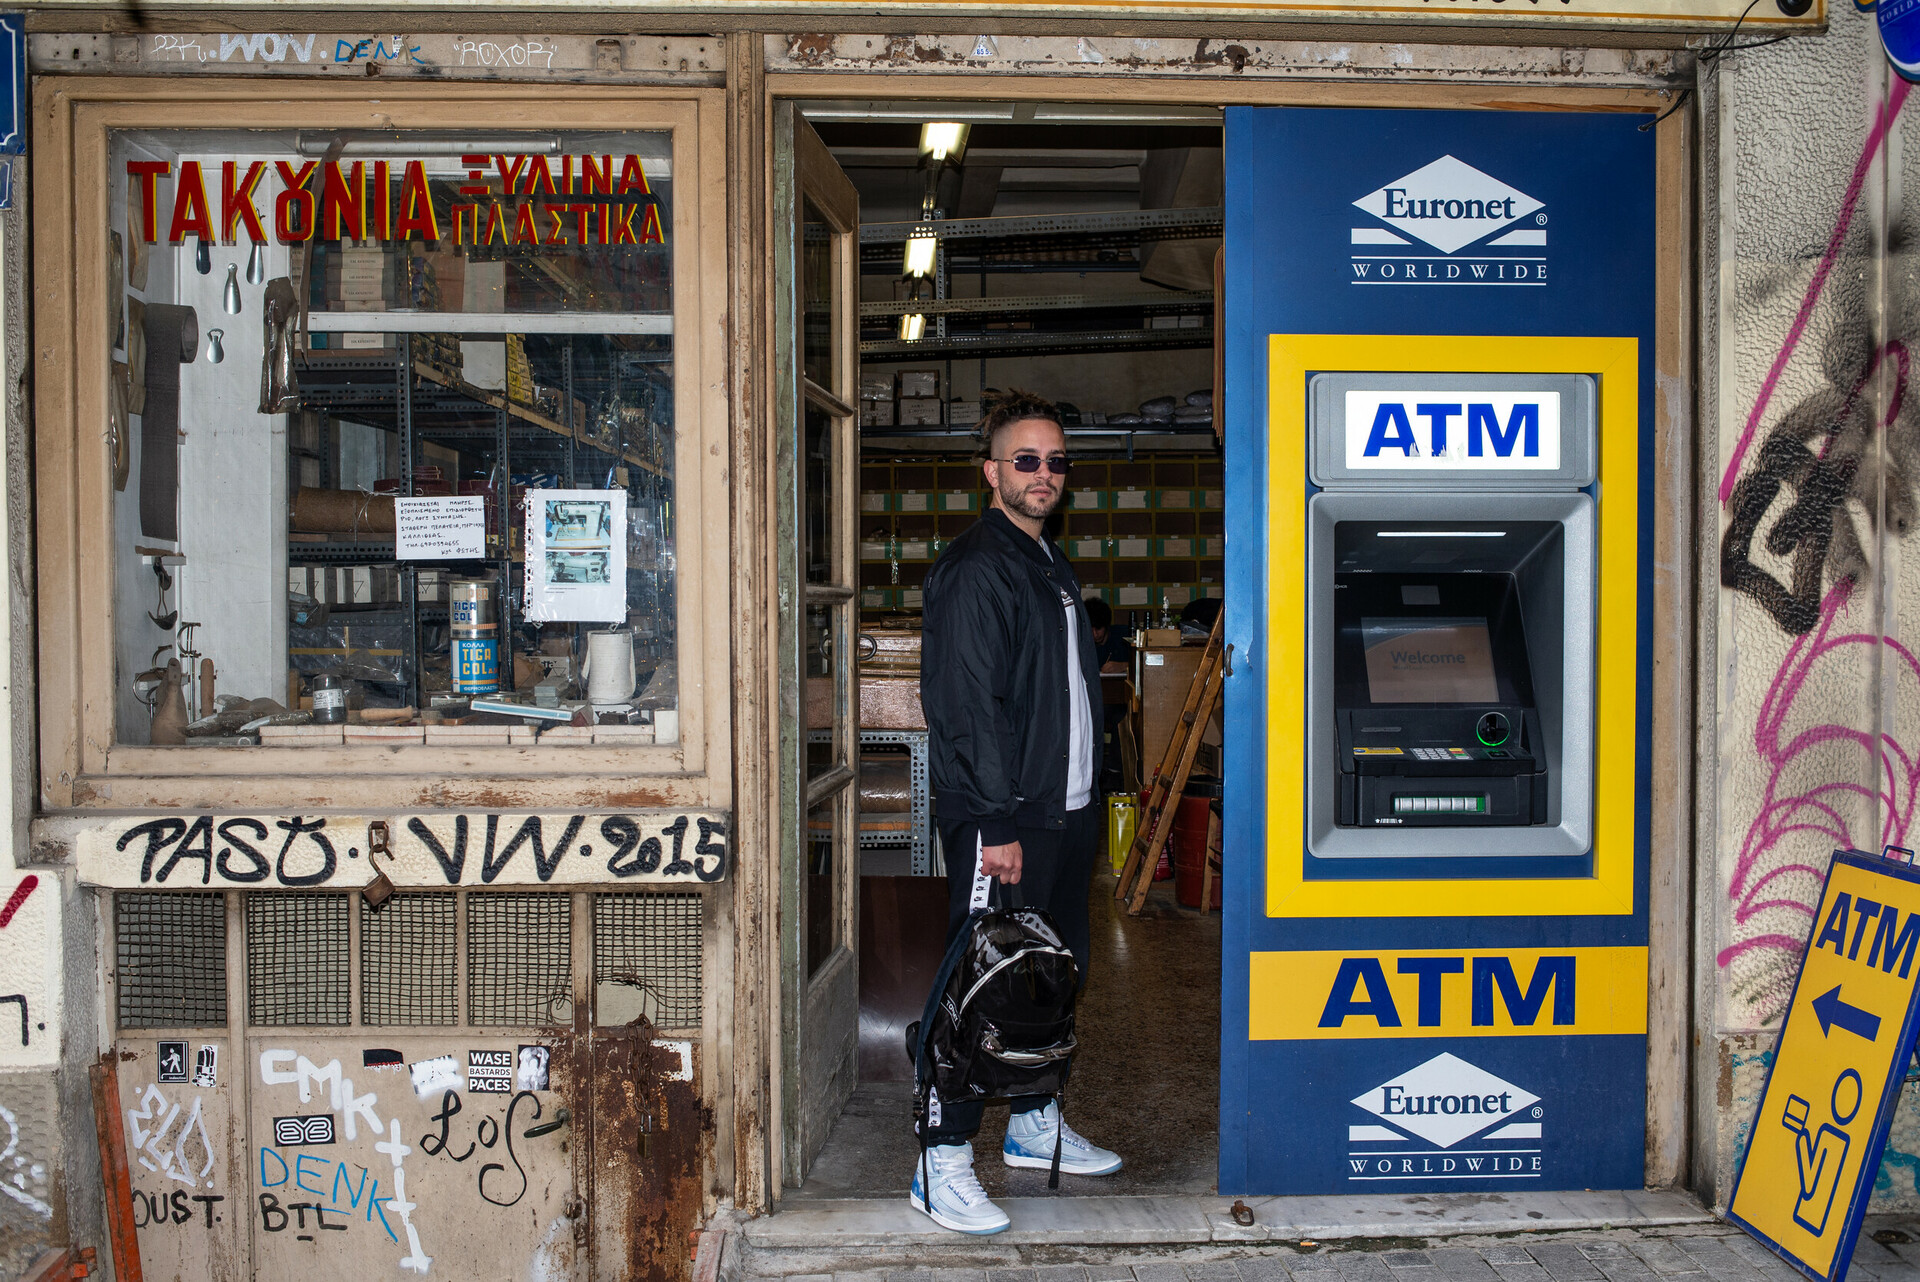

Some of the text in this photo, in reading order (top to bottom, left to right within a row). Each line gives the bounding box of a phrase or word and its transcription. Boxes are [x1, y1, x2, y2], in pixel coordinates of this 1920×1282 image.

[460, 154, 651, 195] ΞΥΛΙΝΑ
[1382, 188, 1516, 221] Euronet
[451, 203, 665, 246] ΠΛΑΣΤΙΚΑ
[1352, 263, 1547, 279] WORLDWIDE
[1363, 403, 1540, 457] ATM
[1390, 651, 1466, 664] Welcome
[600, 816, 726, 883] 2015
[1815, 892, 1920, 981] ATM
[1317, 956, 1577, 1028] ATM
[469, 1067, 511, 1076] BASTARDS
[470, 1052, 511, 1065] WASE
[469, 1078, 511, 1091] PACES
[1380, 1085, 1512, 1115] Euronet
[1349, 1156, 1542, 1173] WORLDWIDE
